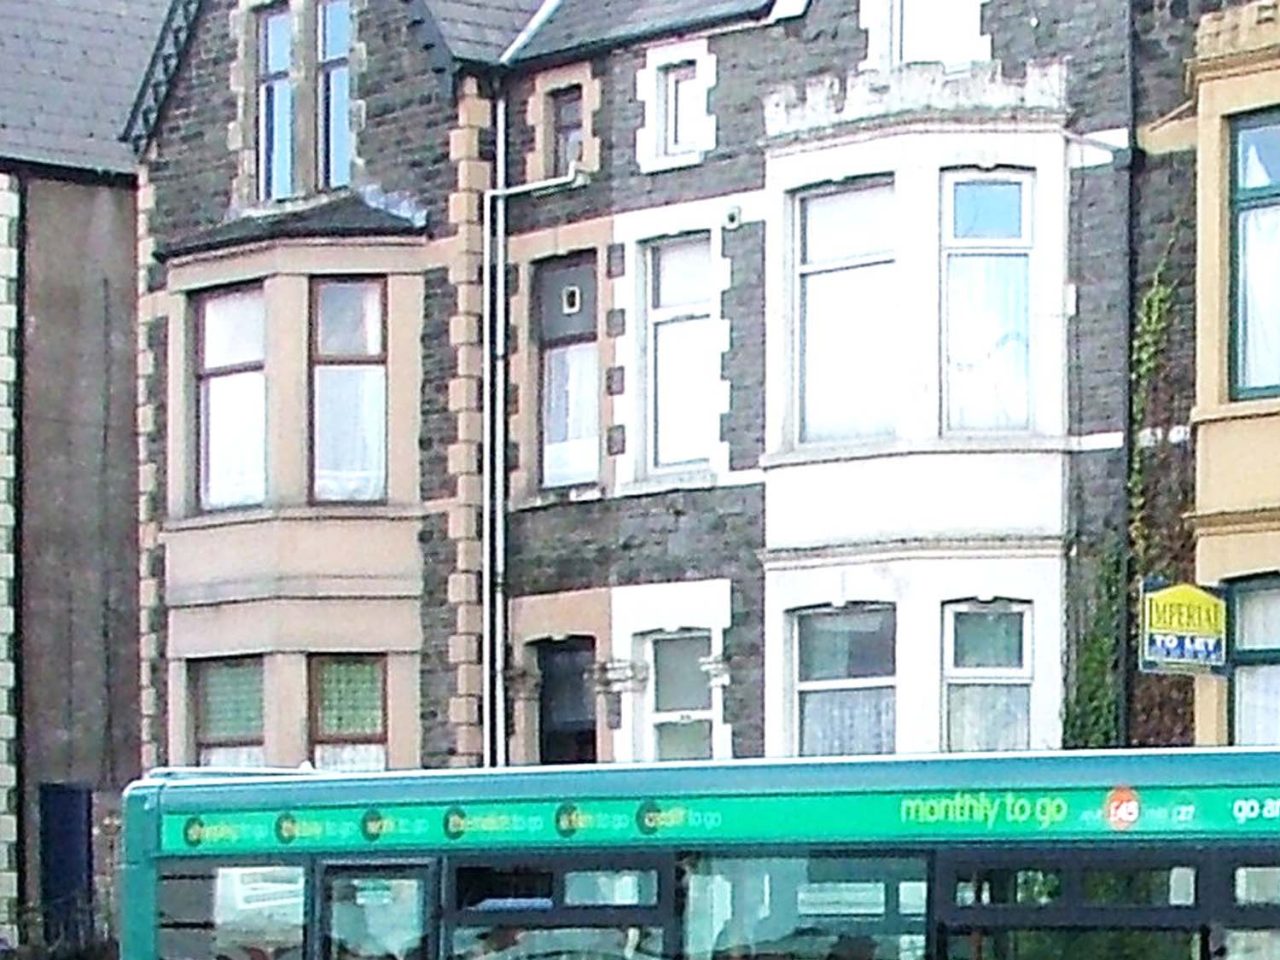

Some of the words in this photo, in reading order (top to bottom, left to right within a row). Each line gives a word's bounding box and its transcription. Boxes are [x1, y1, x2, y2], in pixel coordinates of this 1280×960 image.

[1148, 597, 1221, 632] IMPERIAL
[1152, 634, 1179, 650] TO
[1184, 636, 1218, 652] LET
[901, 792, 999, 829] monthly
[1004, 793, 1030, 823] to
[1035, 798, 1068, 828] go
[1233, 798, 1260, 822] go
